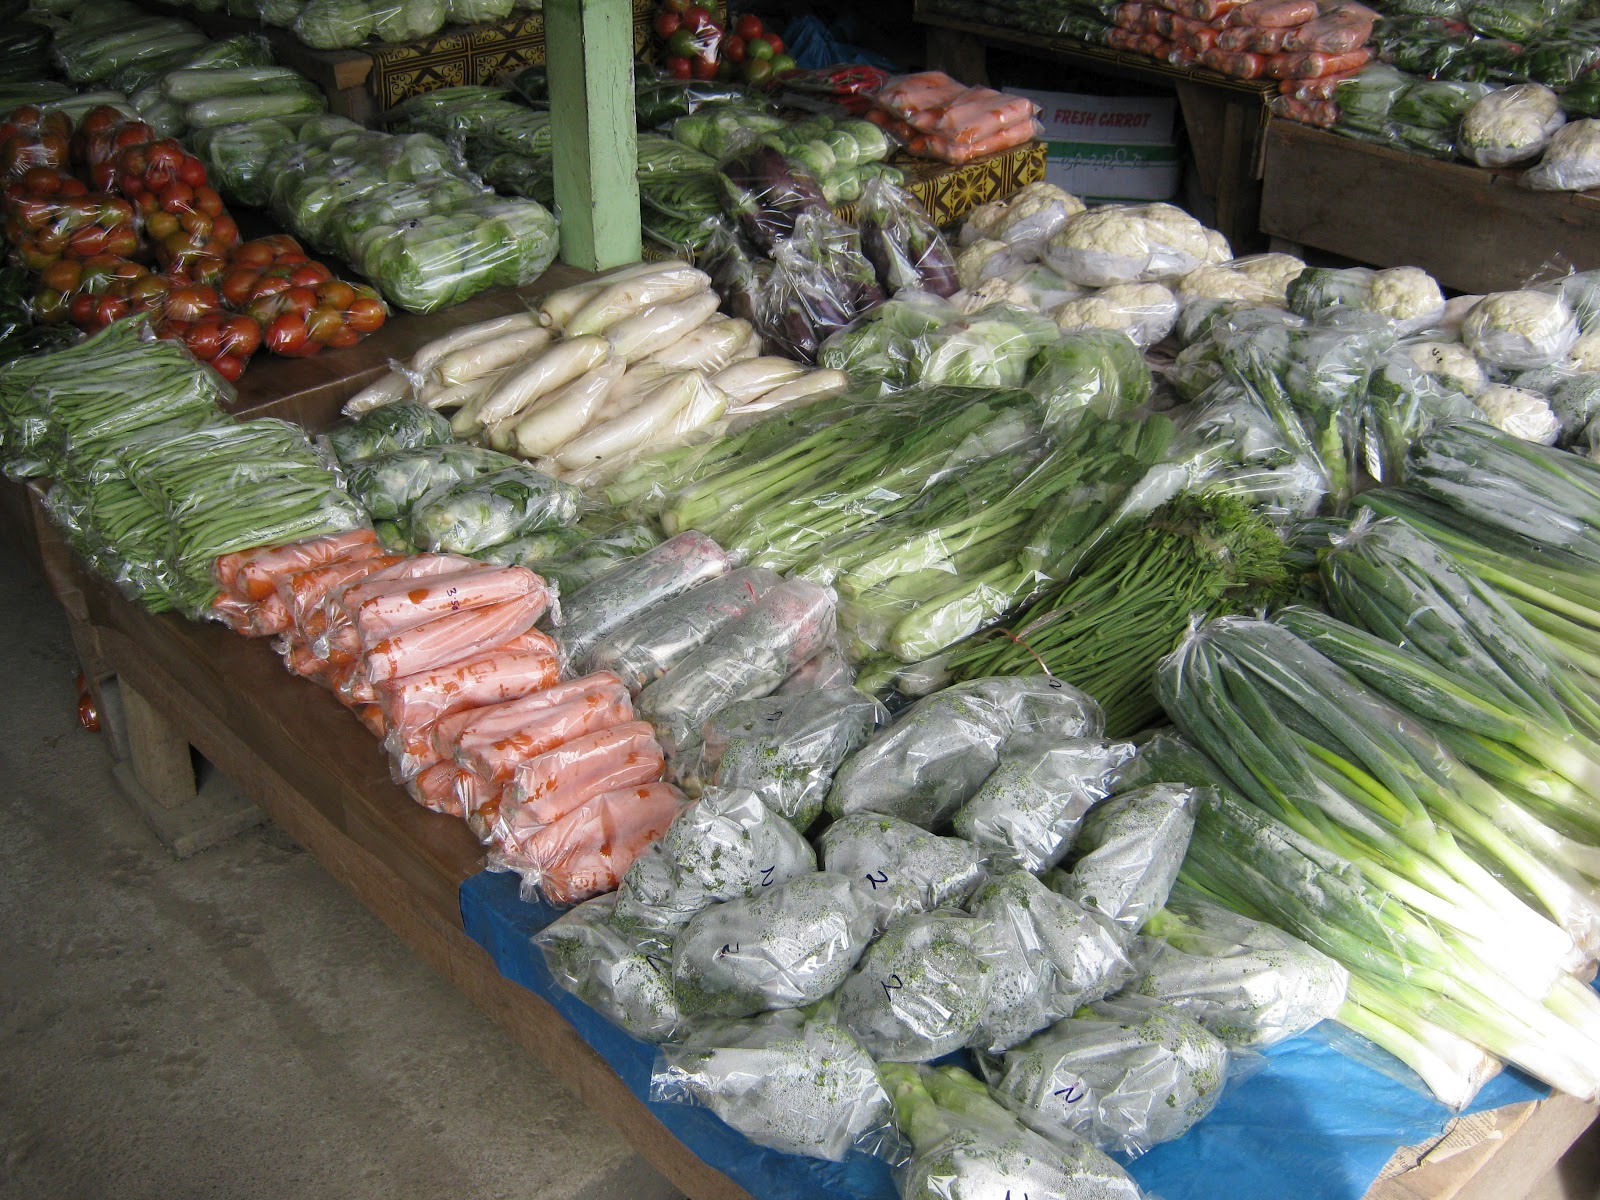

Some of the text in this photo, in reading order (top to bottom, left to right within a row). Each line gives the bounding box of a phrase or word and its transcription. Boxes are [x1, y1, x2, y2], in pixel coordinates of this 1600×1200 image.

[1053, 109, 1152, 128] FRESH CARROT
[760, 864, 776, 888] 2
[865, 869, 889, 890] 2
[880, 973, 903, 1003] 2
[1053, 1081, 1084, 1104] 2
